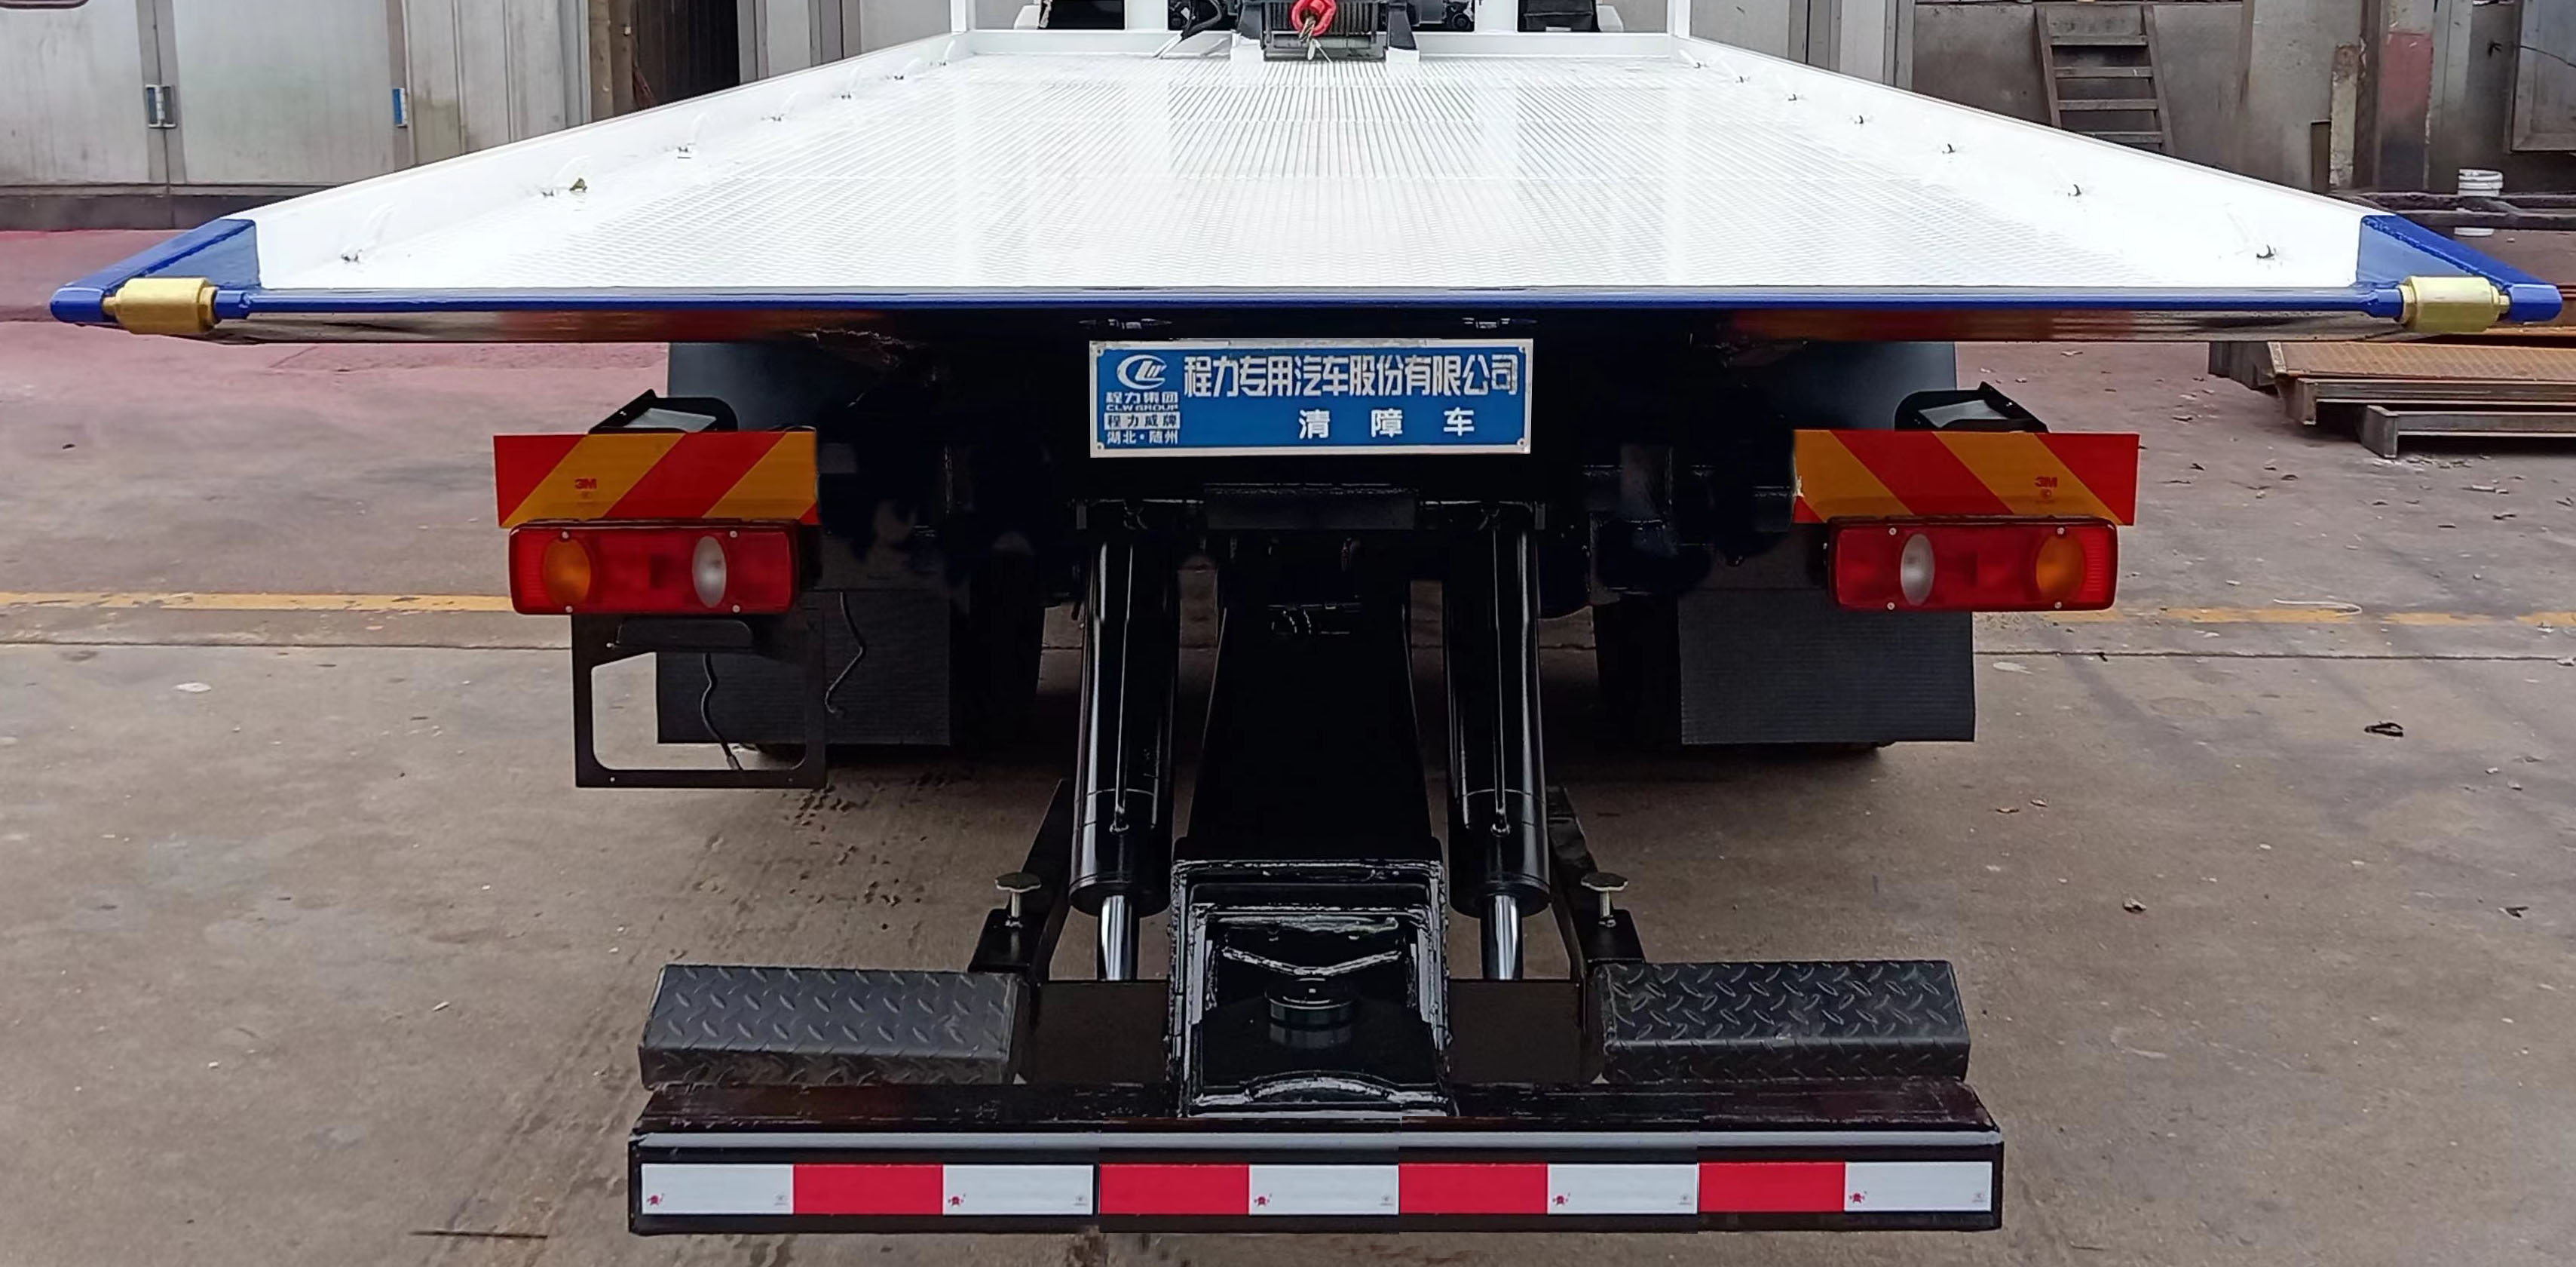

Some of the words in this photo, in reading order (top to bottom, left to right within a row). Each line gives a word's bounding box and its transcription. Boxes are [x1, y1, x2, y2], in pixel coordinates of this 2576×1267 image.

[1184, 354, 1519, 398] 程力专用汽车股份有限公司
[1105, 391, 1179, 404] 程力集团
[575, 478, 597, 489] 3M
[2035, 477, 2057, 488] 3M
